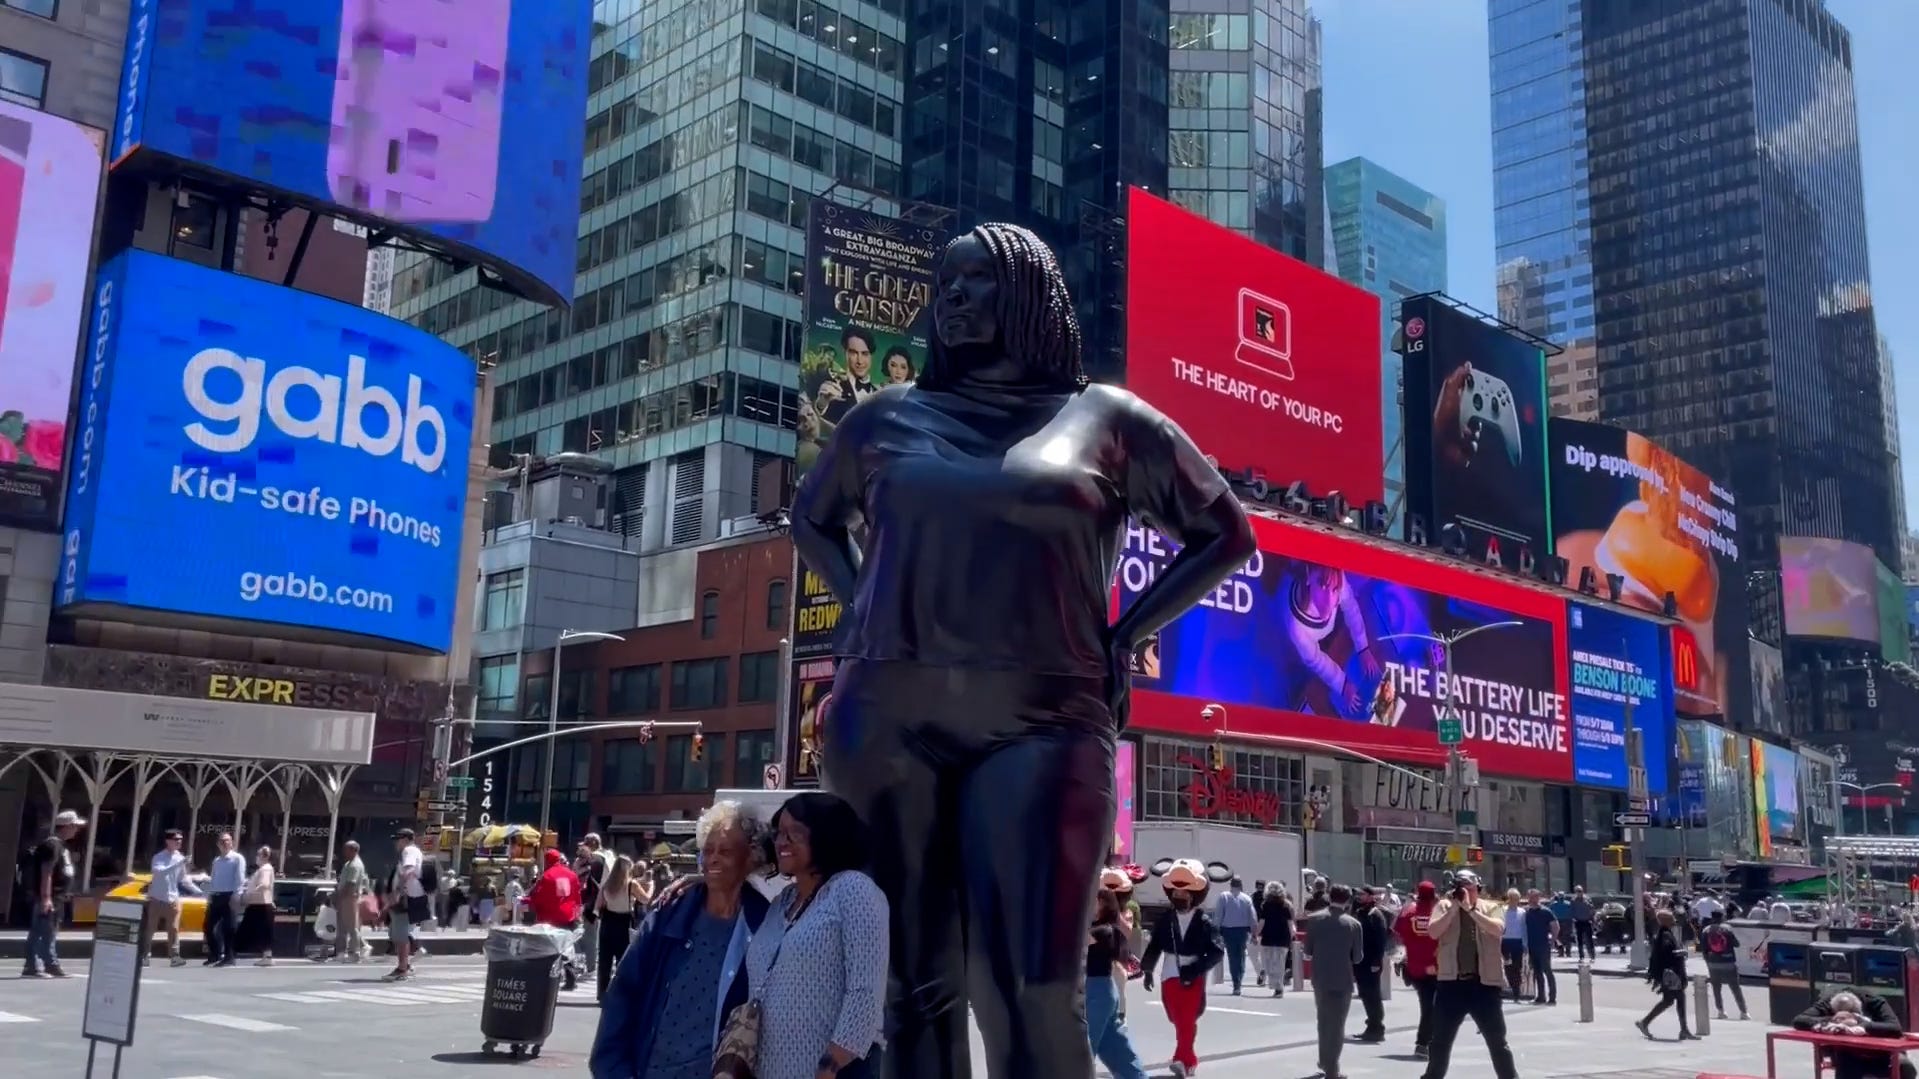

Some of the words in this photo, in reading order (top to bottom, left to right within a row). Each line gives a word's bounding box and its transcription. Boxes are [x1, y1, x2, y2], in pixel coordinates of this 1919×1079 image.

[846, 241, 917, 265] EXTRAVAGANZA
[867, 236, 883, 247] BIG
[885, 240, 935, 259] BROADWAY
[824, 262, 860, 292] THE
[864, 271, 931, 308] GREAT
[834, 290, 920, 329] GATSBY
[856, 320, 872, 330] NEW
[1408, 340, 1424, 353] LG
[183, 347, 446, 473] gabb
[1171, 357, 1203, 386] THE
[1206, 369, 1257, 404] HEART
[1260, 389, 1280, 410] OF
[1282, 396, 1321, 427] YOUR
[1324, 411, 1343, 433] PC
[1565, 444, 1597, 472] Dip
[170, 464, 341, 520] Kid-safe
[349, 496, 441, 548] Phones
[240, 571, 393, 613] gabb.com
[799, 604, 842, 633] REDW
[208, 674, 349, 706] EXPRESS
[1385, 662, 1431, 698] THE
[1436, 671, 1524, 714] BATTERY
[1528, 689, 1565, 721] LIFE
[1574, 662, 1618, 692] BENSON
[1621, 673, 1656, 699] BOONE
[1482, 712, 1567, 752] DESERVE
[480, 761, 493, 826] 1540
[1376, 762, 1469, 813] FOREVR
[491, 988, 528, 1002] SQUARE
[497, 977, 526, 990] TIMES
